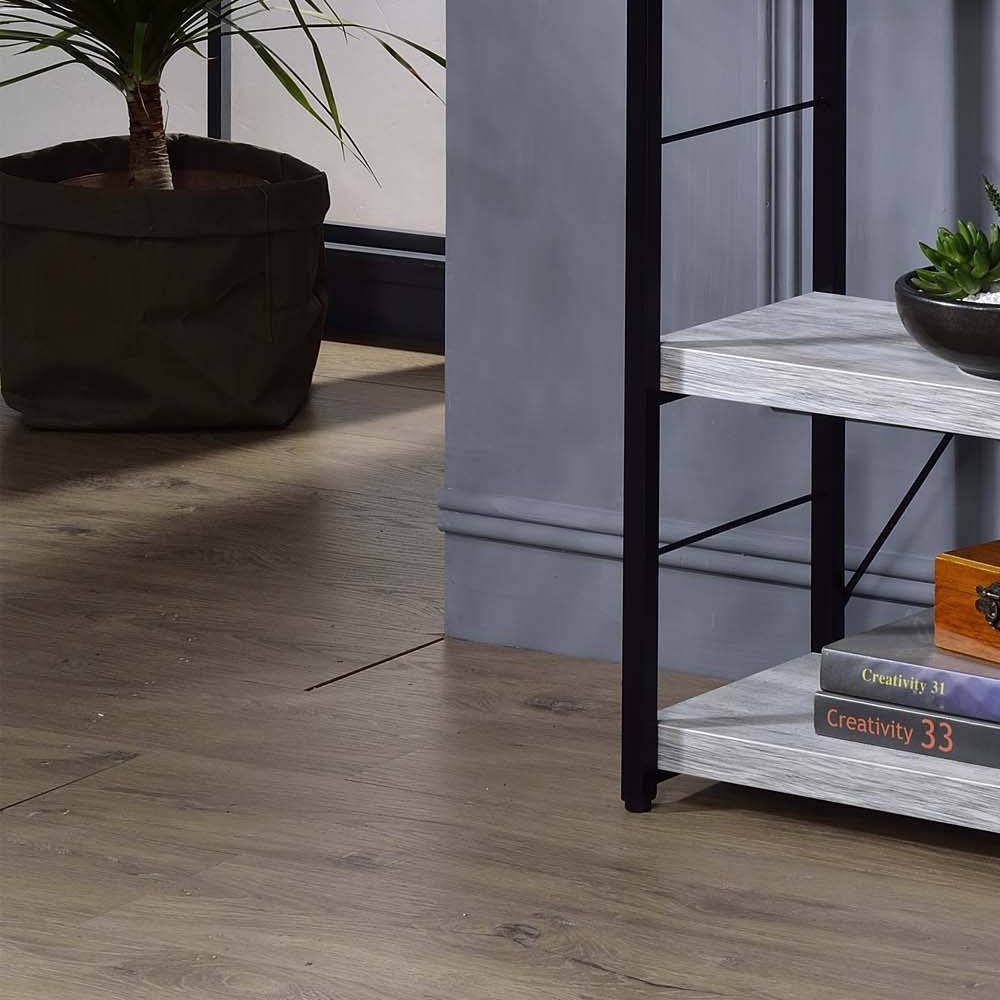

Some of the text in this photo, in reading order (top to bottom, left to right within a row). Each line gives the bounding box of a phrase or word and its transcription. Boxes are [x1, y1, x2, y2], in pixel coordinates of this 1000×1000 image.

[861, 667, 945, 696] Creativity 31
[826, 708, 955, 753] Creativity 33
